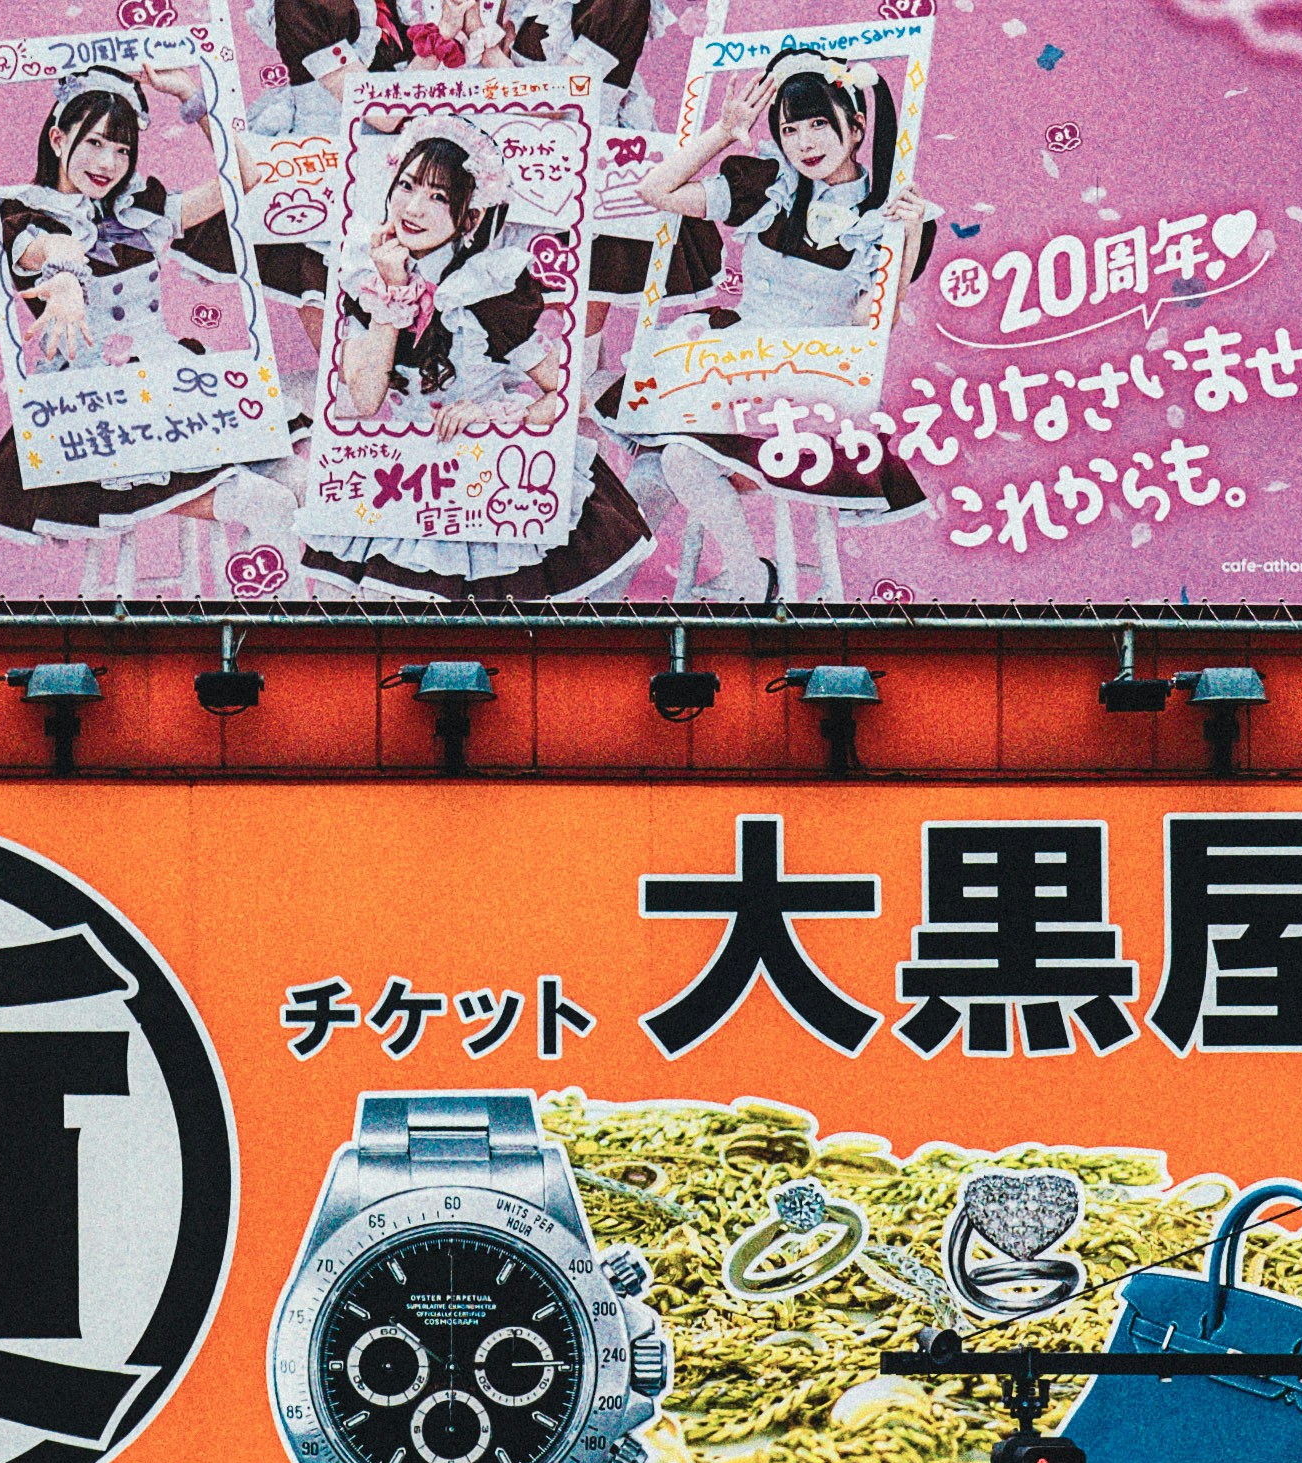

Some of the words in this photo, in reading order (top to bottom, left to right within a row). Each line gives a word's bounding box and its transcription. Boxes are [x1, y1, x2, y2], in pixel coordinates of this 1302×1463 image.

[990, 214, 1212, 334] 20周年
[949, 438, 1247, 554] これからも。
[282, 979, 595, 1059] チケット
[444, 1196, 461, 1212] 60
[368, 1213, 387, 1230] 65
[496, 1197, 530, 1221] UNITS
[533, 1213, 556, 1235] PER
[568, 1258, 594, 1275] 400
[592, 1301, 618, 1318] 300
[602, 1347, 627, 1364] 240
[598, 1395, 623, 1412] 200
[286, 1405, 303, 1420] 85
